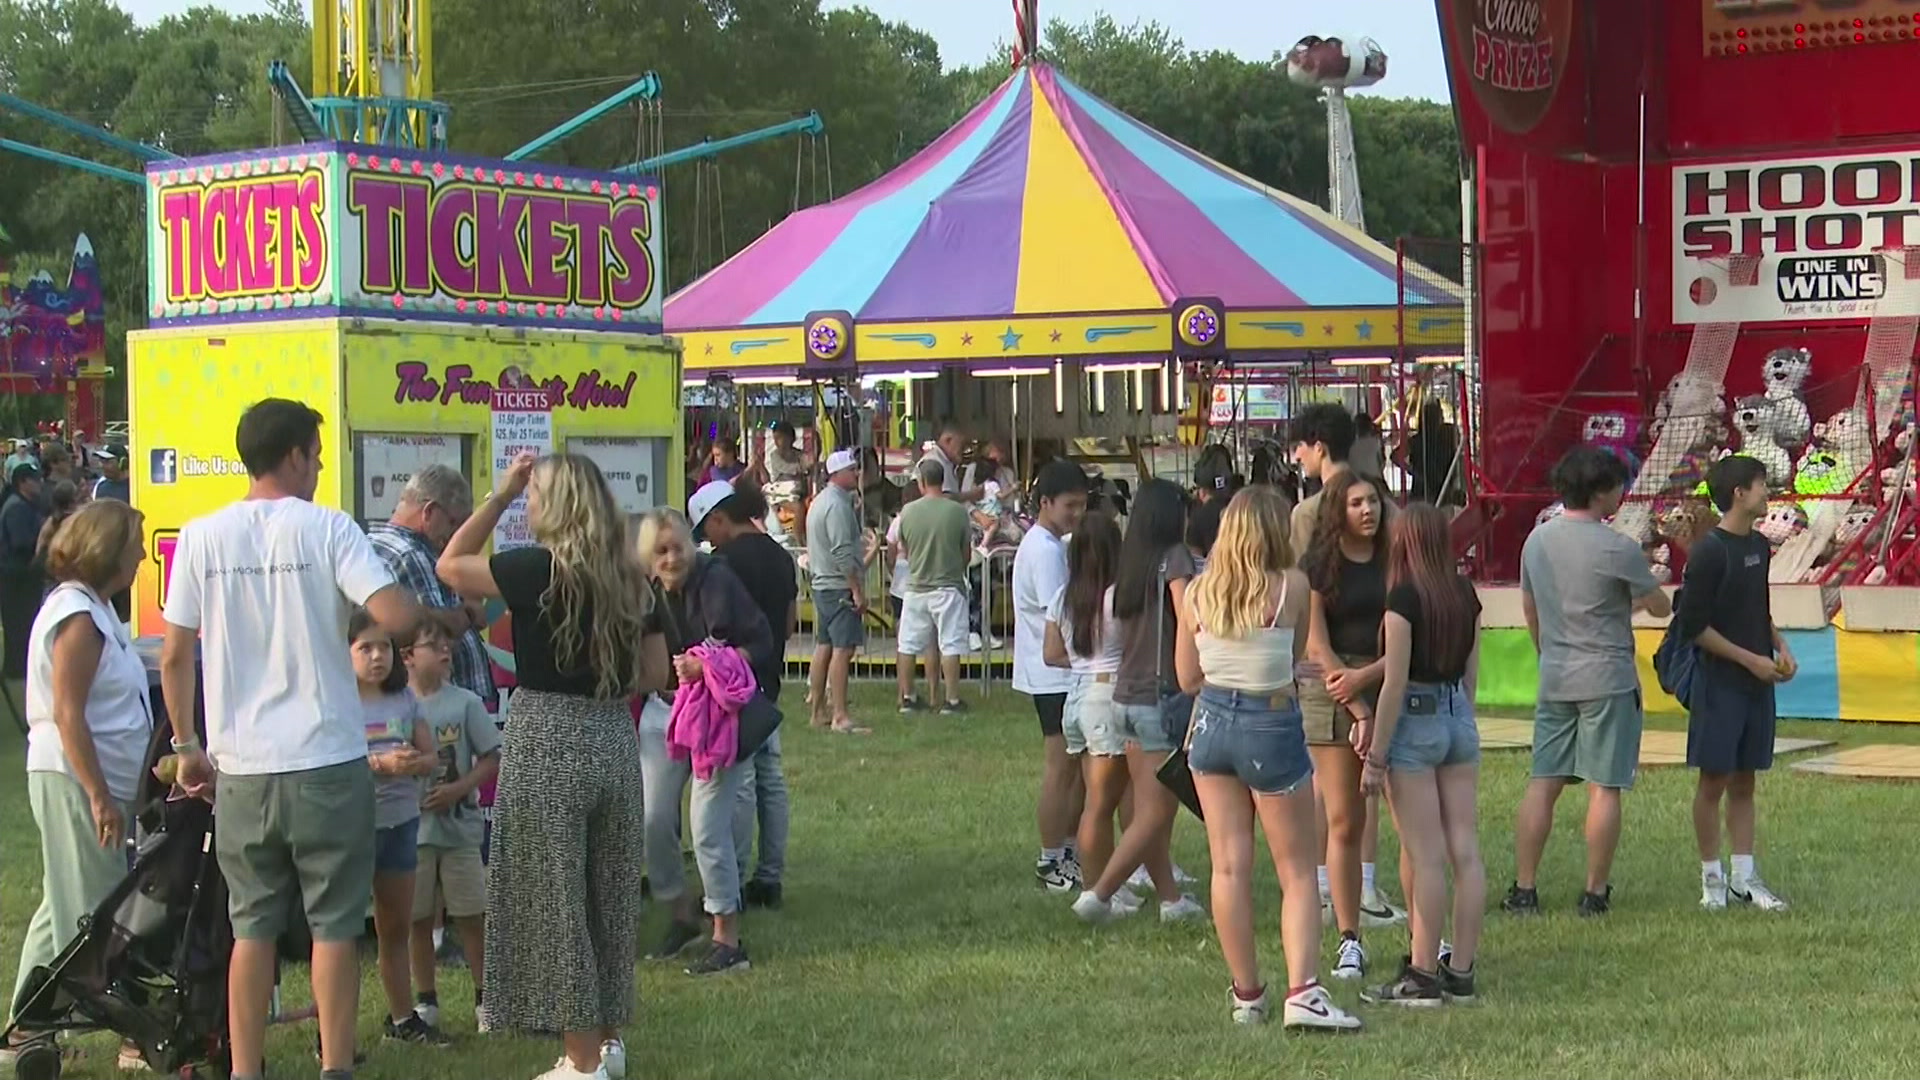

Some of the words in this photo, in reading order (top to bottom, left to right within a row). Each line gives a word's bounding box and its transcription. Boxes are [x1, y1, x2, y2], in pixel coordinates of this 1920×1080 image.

[1485, 0, 1539, 36] Choice
[1473, 25, 1552, 91] PRIZE
[1684, 158, 1920, 216] HOO
[160, 170, 328, 303] TICKETS
[347, 170, 655, 308] TICKETS
[1795, 260, 1837, 274] ONE
[1847, 258, 1868, 272] IN
[1779, 273, 1883, 300] WINS
[395, 361, 440, 404] The
[441, 364, 492, 406] Fun
[494, 391, 549, 408] TICKETS
[516, 416, 526, 426] per
[527, 413, 546, 425] Ticket
[519, 428, 527, 440] 25
[528, 428, 549, 440] Tickets
[182, 457, 210, 476] Like
[212, 455, 230, 475] Us
[231, 460, 248, 475] on
